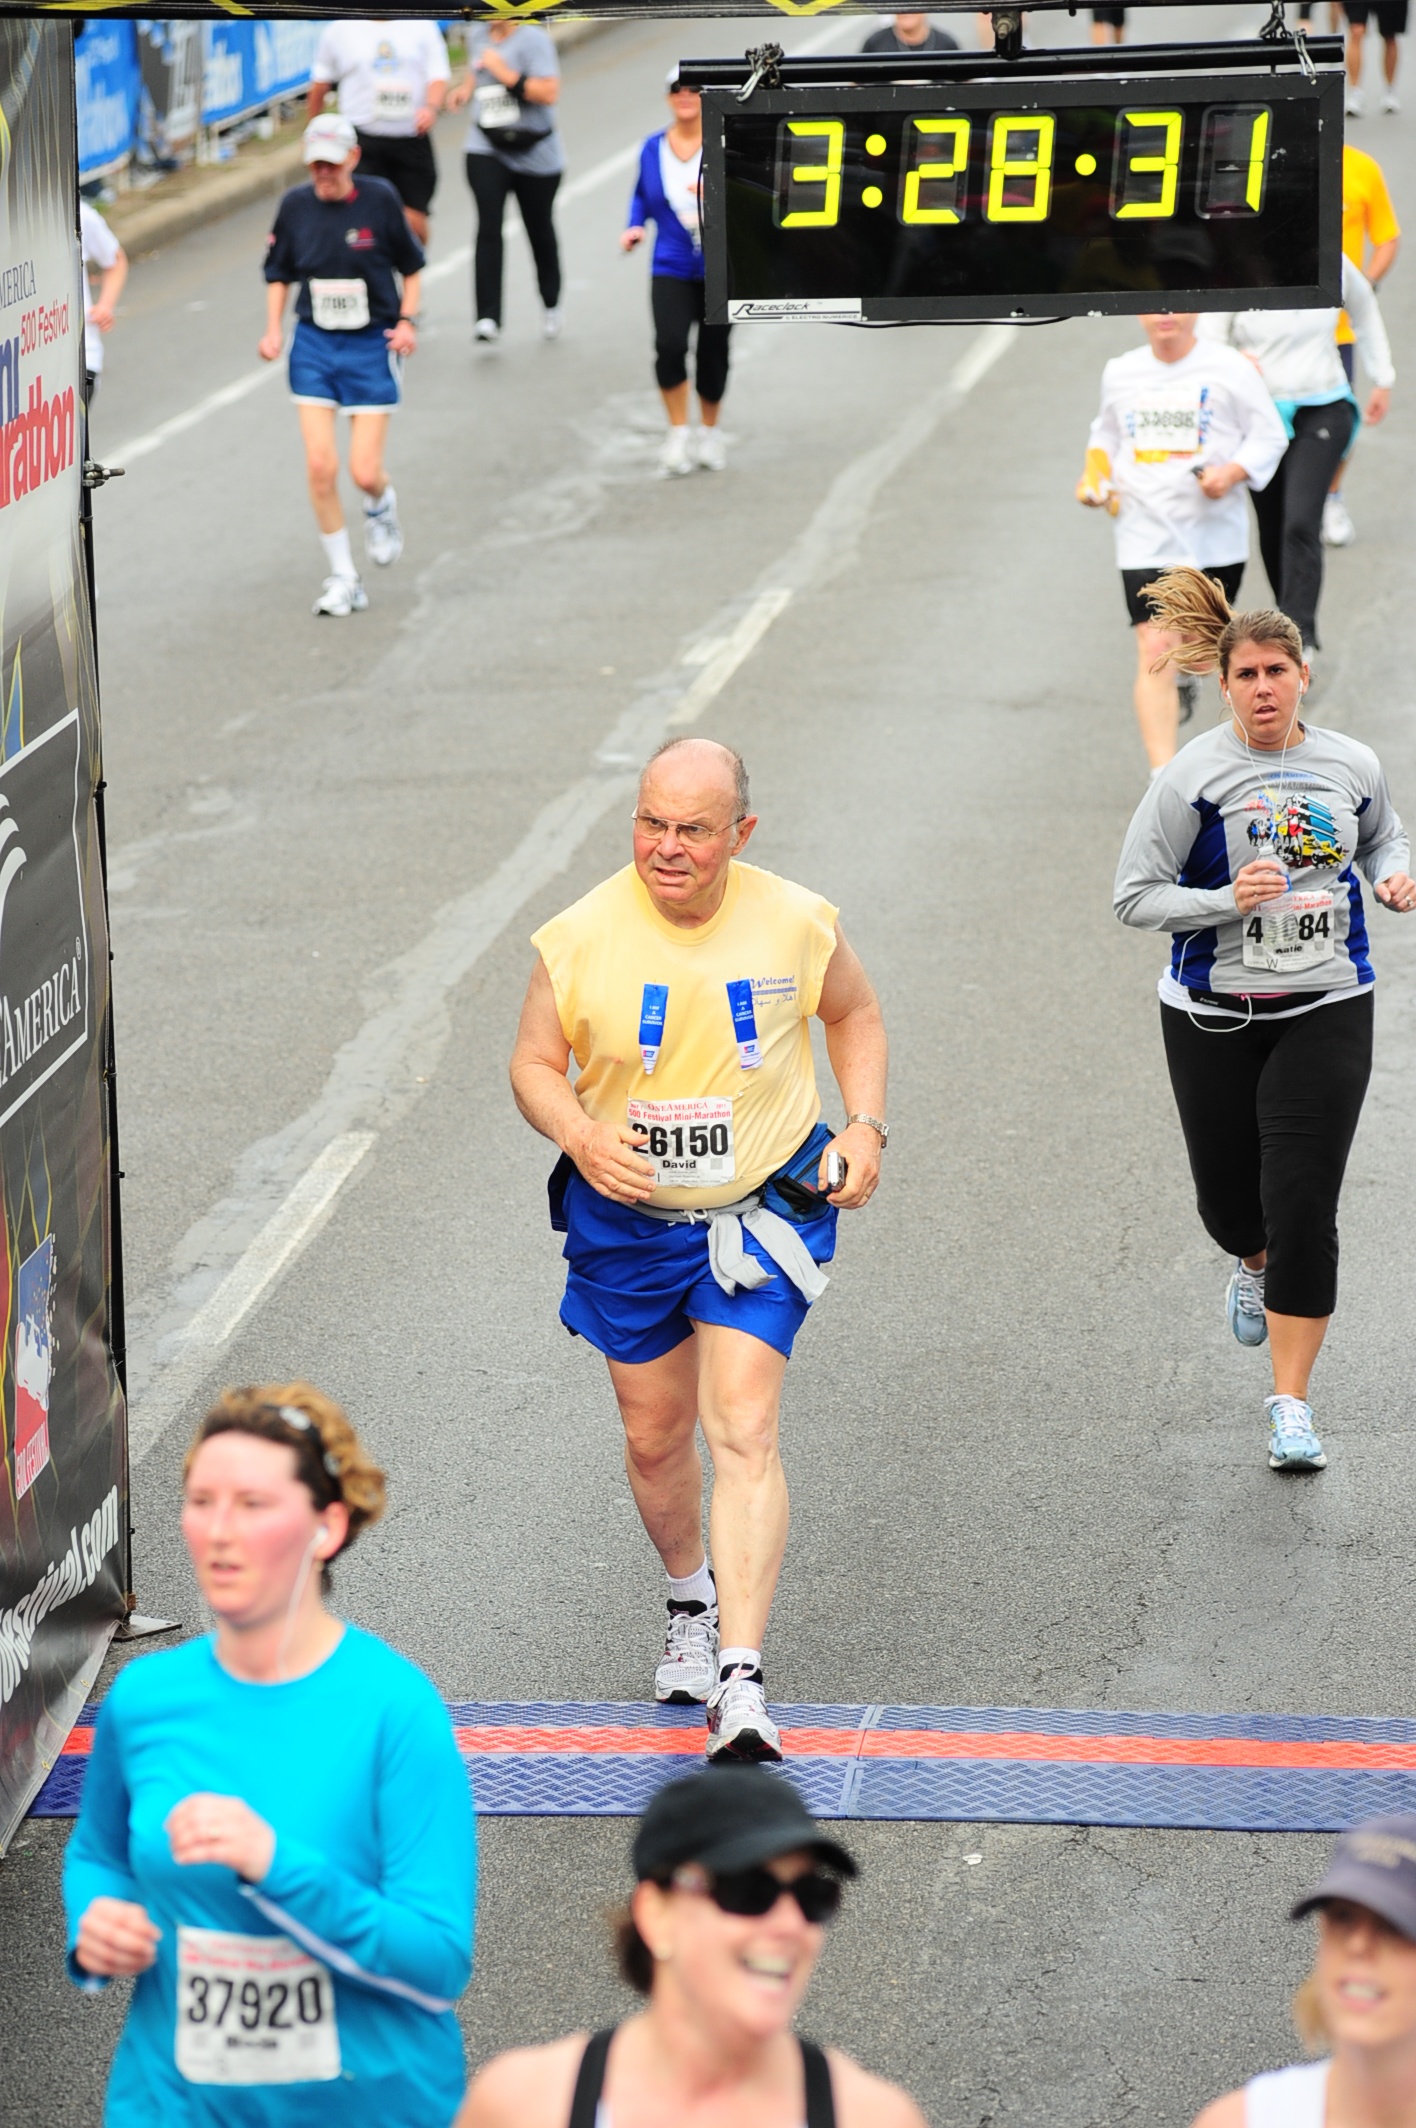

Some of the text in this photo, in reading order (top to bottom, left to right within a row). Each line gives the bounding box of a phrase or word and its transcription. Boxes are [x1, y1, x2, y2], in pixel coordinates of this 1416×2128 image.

[732, 302, 811, 316] Raceclock
[21, 293, 69, 356] 500 Festival
[1266, 958, 1279, 969] W
[751, 974, 795, 989] Welcome!
[0, 956, 82, 1088] AMERICA
[629, 1108, 731, 1123] 500 Festival Mini-Marathon
[632, 1122, 729, 1157] 26150
[662, 1160, 697, 1169] David
[188, 1975, 323, 2031] 37920
